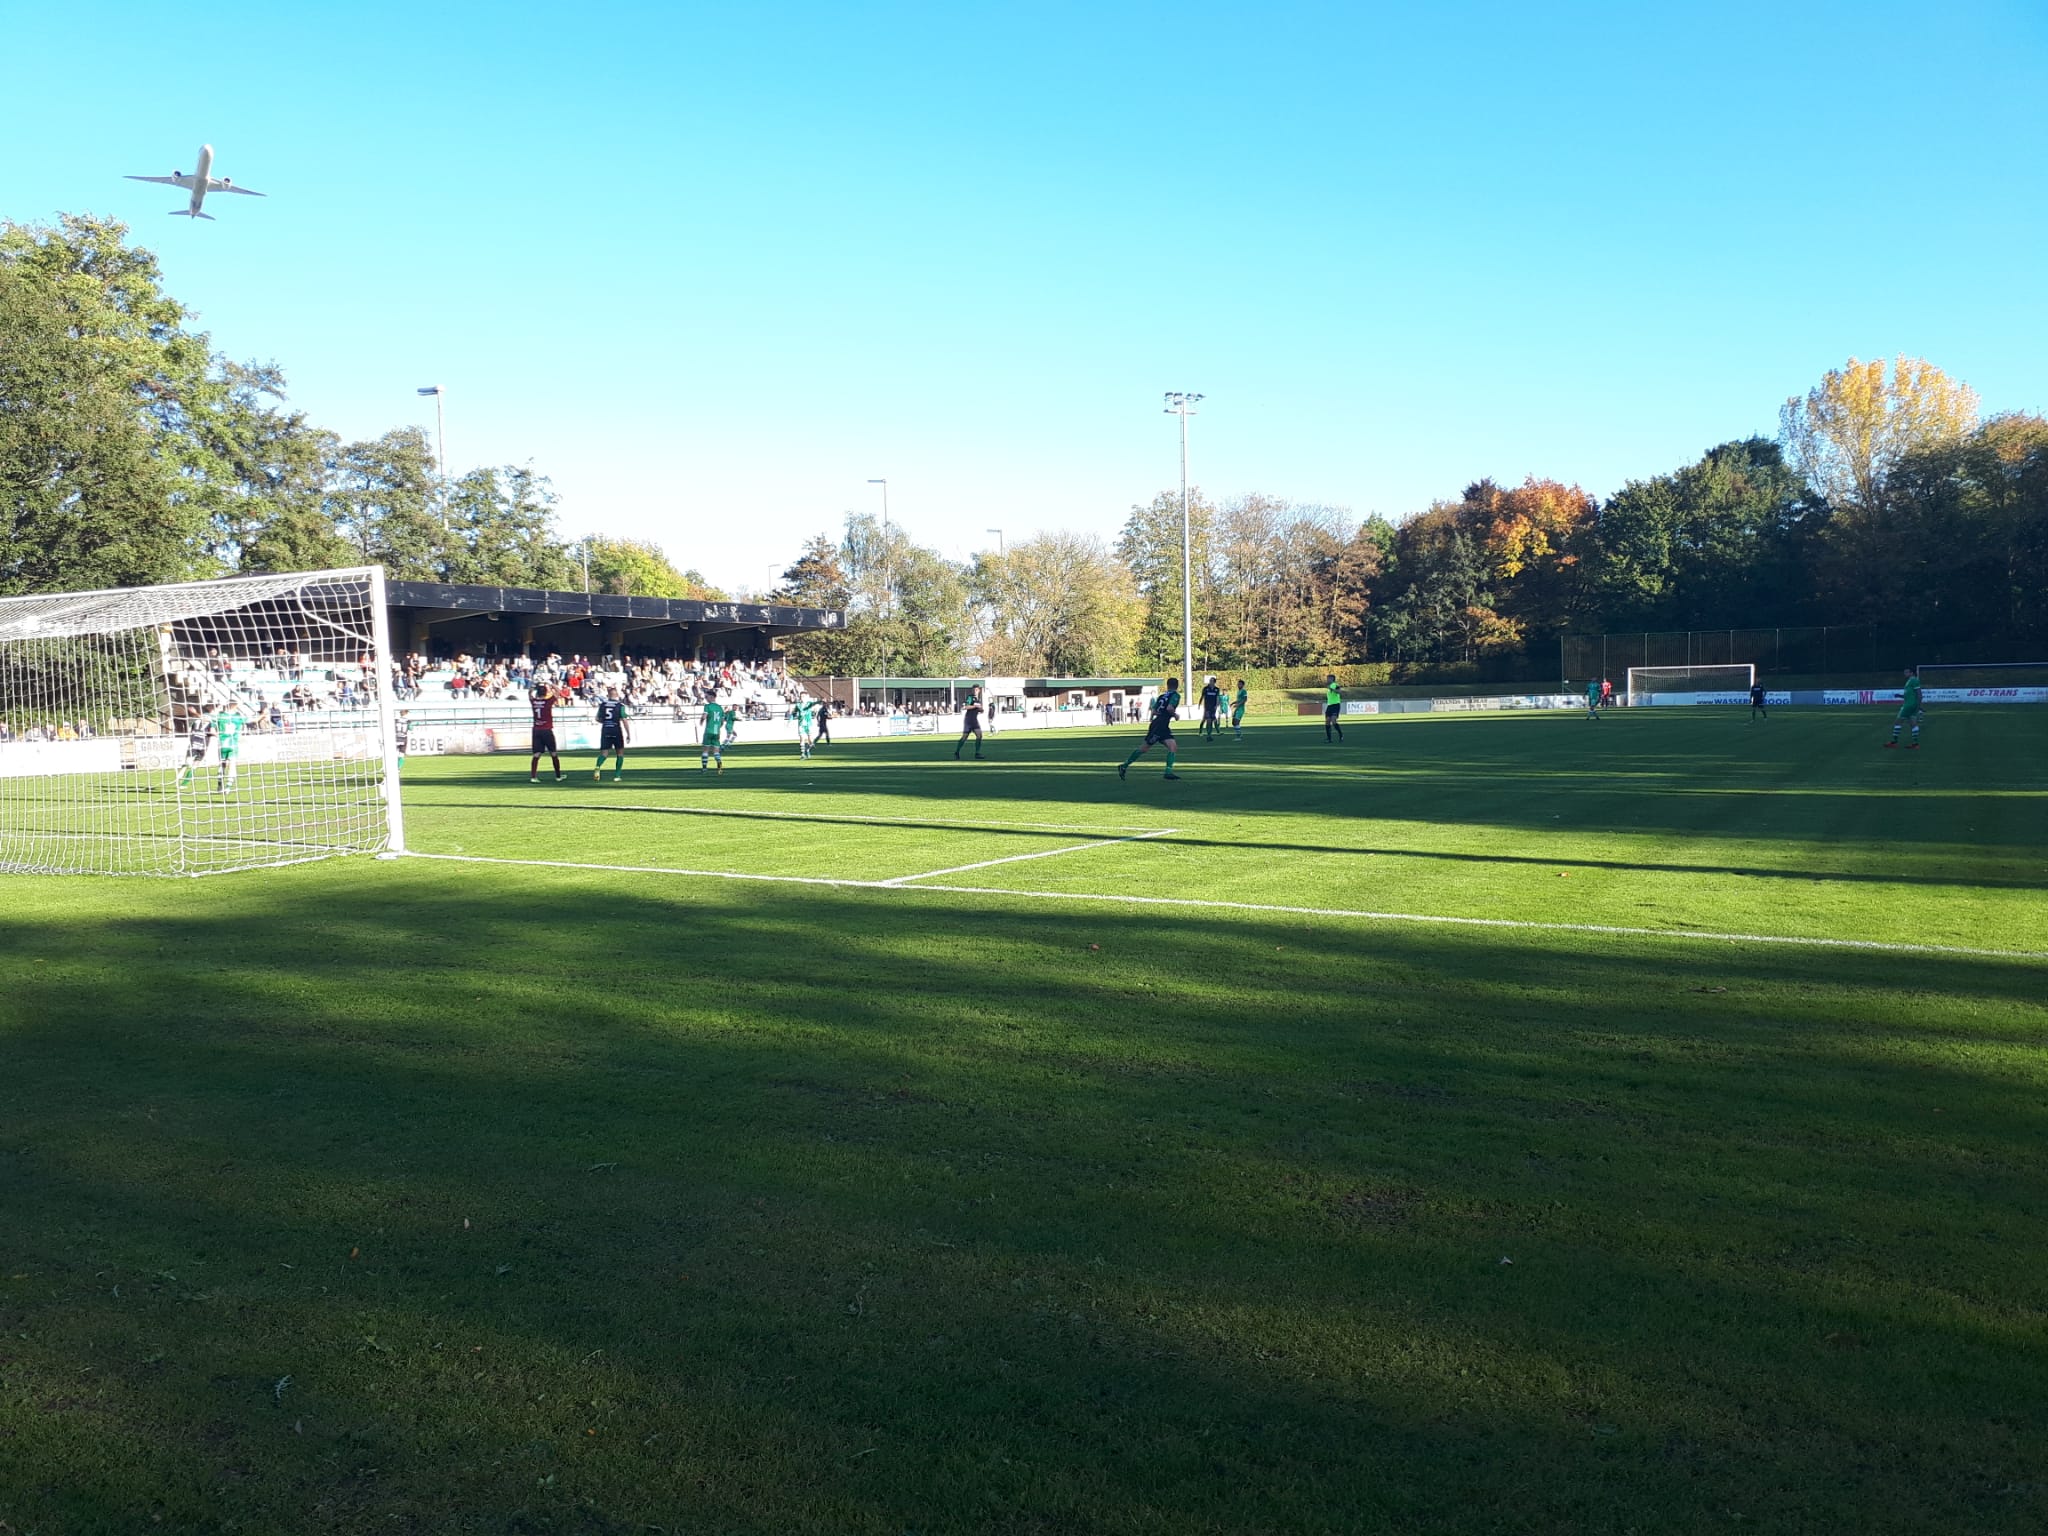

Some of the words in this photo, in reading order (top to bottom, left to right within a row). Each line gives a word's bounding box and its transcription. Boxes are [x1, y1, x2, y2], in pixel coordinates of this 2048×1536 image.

[1966, 689, 2019, 697] JDC-TRANS
[535, 708, 542, 719] 1
[605, 708, 614, 719] 5
[410, 738, 444, 752] BEVE
